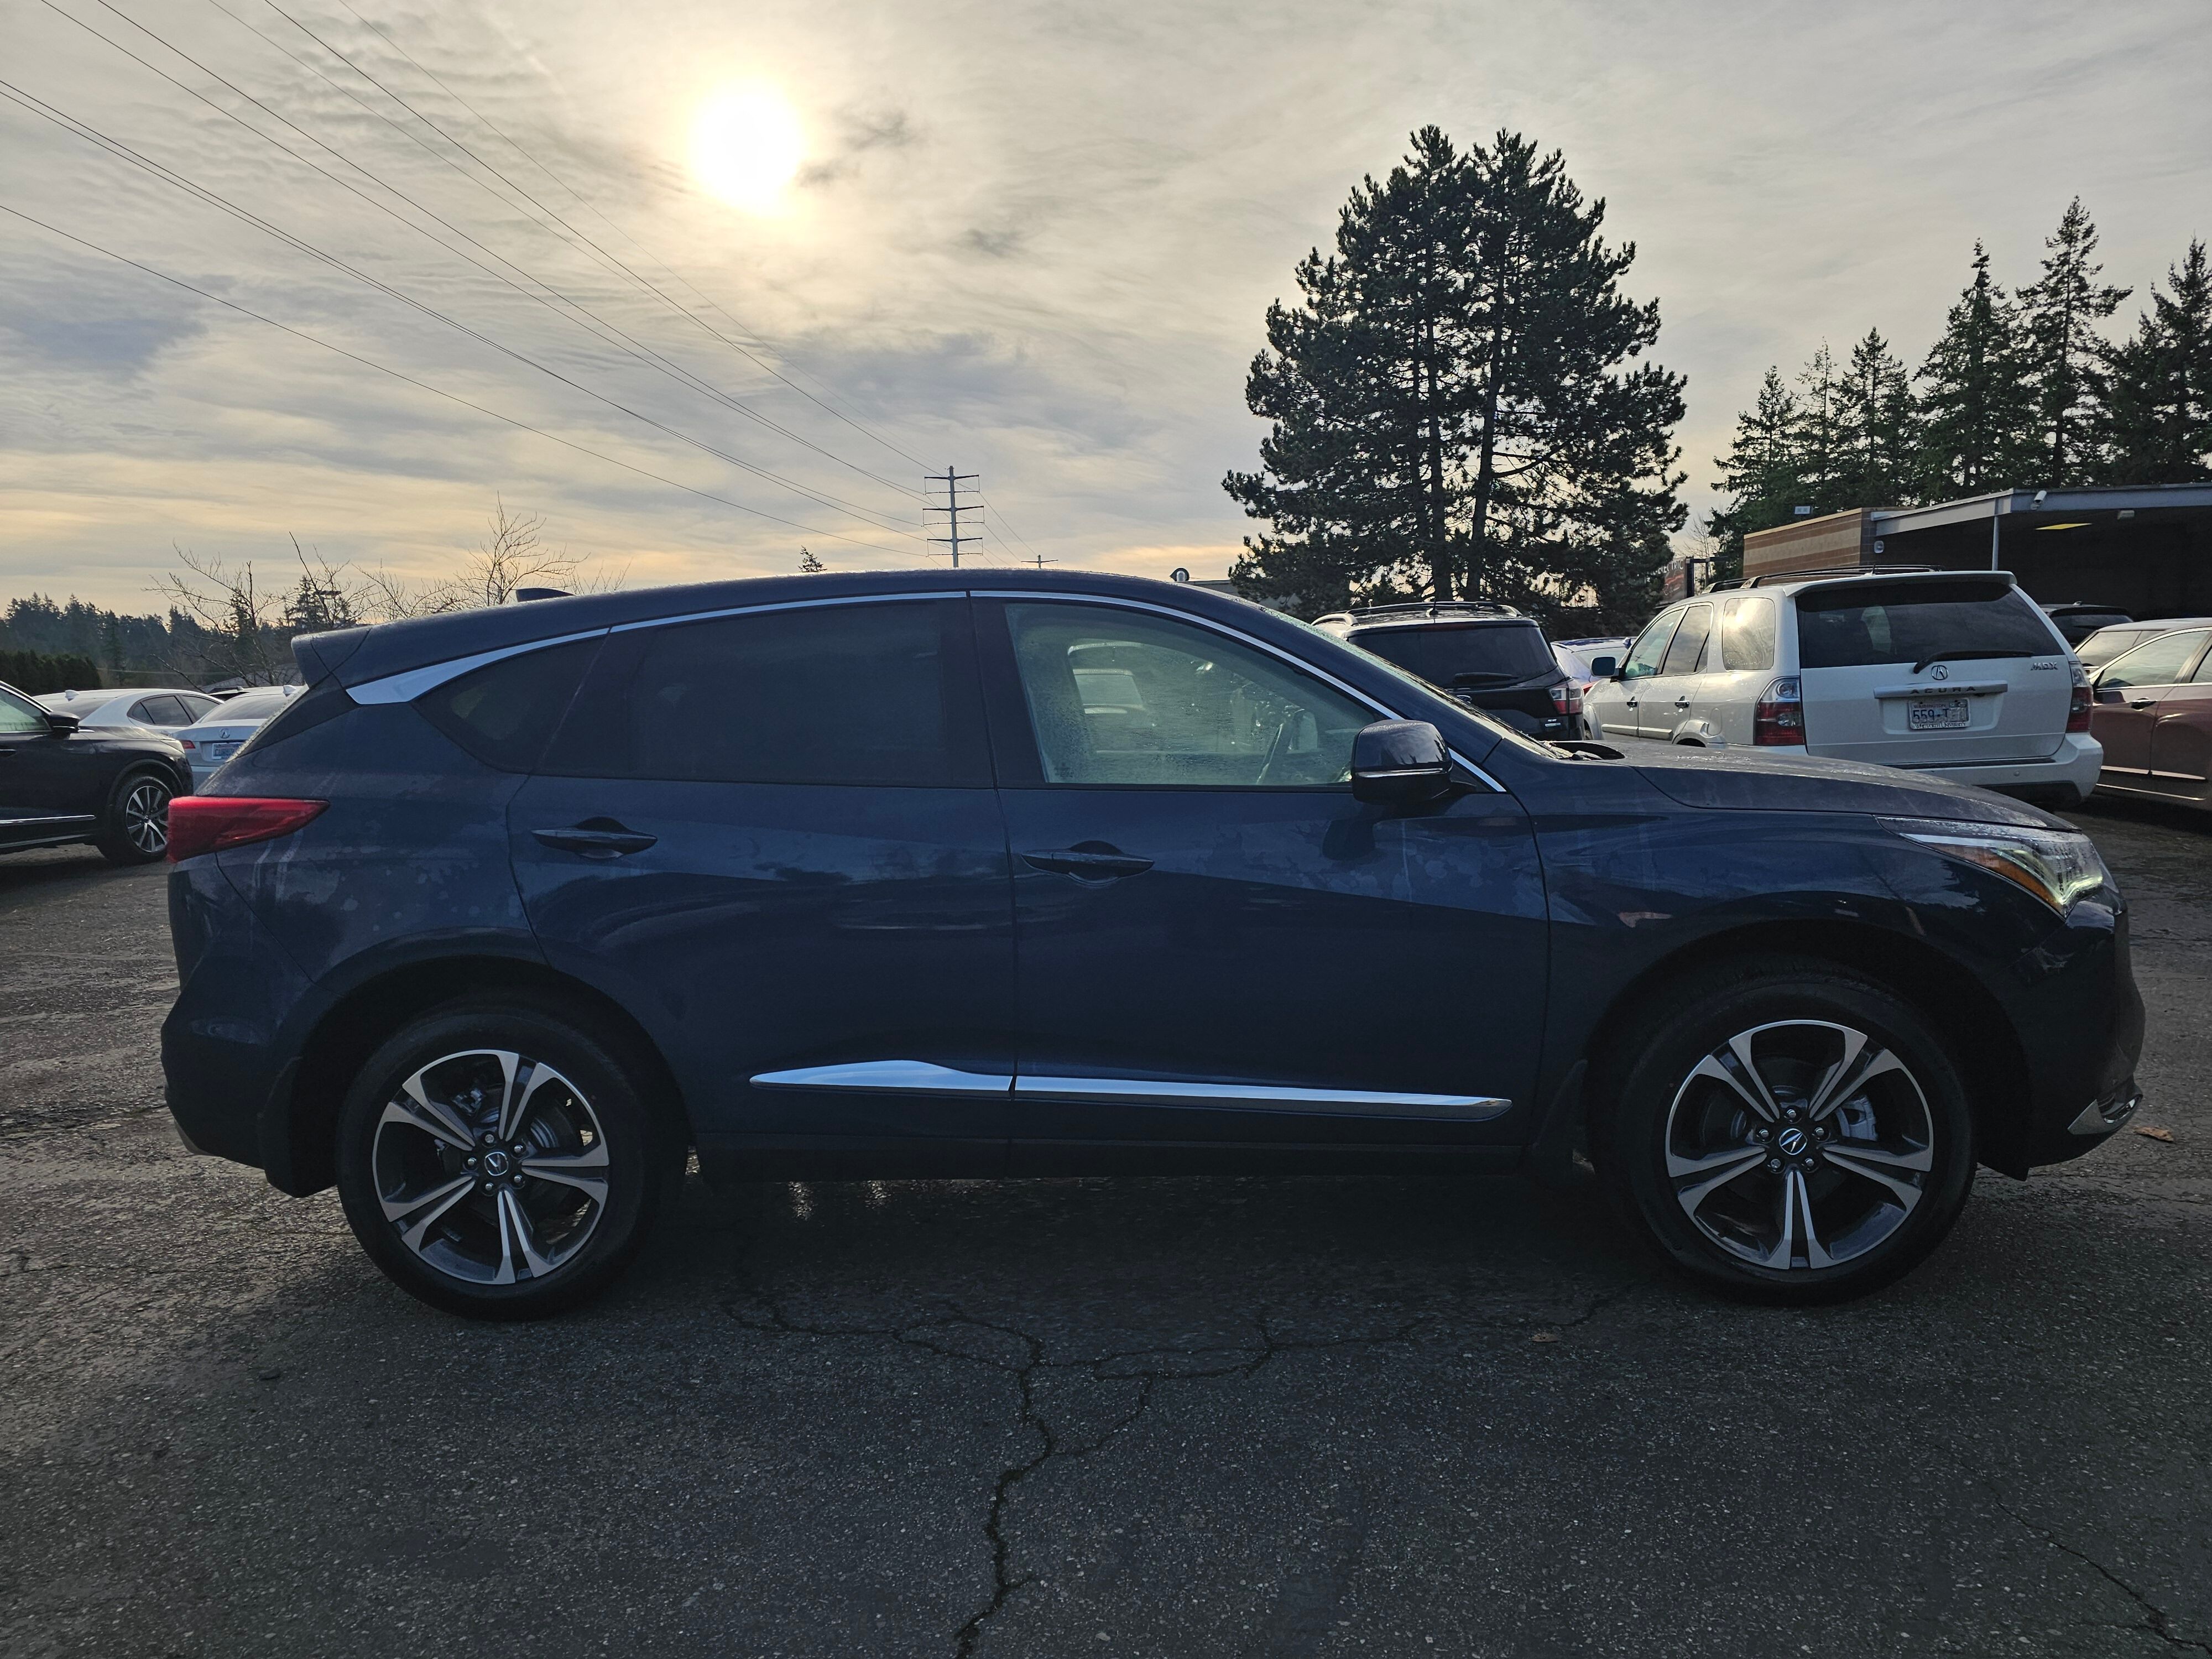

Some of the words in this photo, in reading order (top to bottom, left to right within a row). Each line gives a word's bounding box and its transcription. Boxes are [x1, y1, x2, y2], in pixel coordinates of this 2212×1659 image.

[2030, 661, 2058, 671] MDX
[1910, 686, 1976, 695] ACURA
[1913, 708, 1966, 721] 559-T
